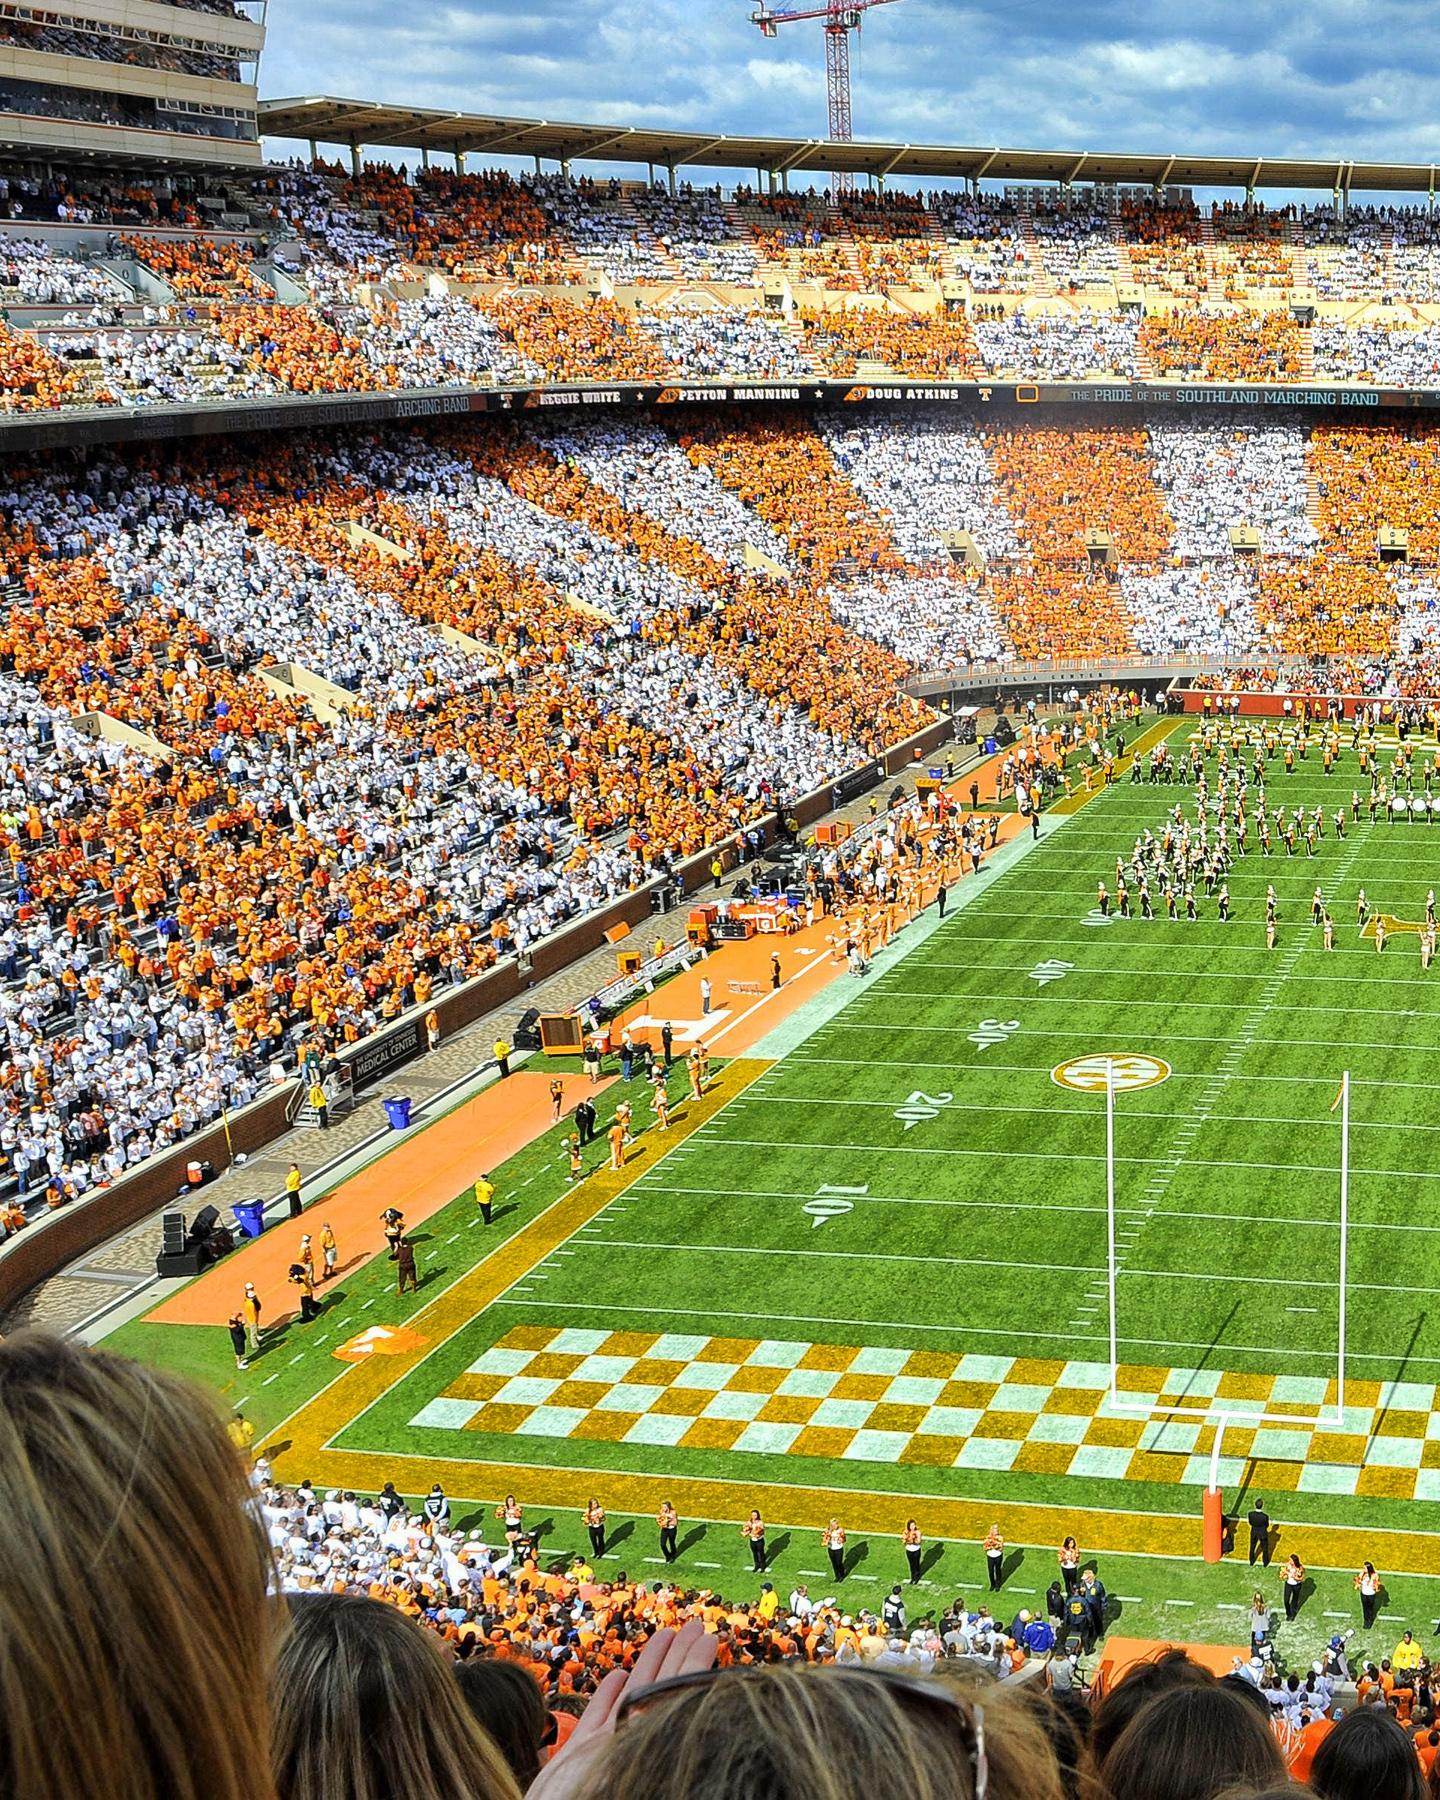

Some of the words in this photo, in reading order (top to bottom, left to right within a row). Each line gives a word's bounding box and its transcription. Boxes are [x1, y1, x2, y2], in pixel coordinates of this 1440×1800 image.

[540, 392, 579, 406] REGGIE
[582, 391, 621, 403] WHITE
[679, 389, 727, 401] PEYTON
[733, 388, 800, 400] MANNING
[866, 388, 902, 400] DOUG
[906, 388, 959, 400] ATKINS
[979, 388, 993, 401] T
[1072, 390, 1091, 401] THE
[1094, 389, 1133, 402] PRIDE
[1137, 391, 1149, 401] OF
[1152, 391, 1171, 401] THE
[1176, 389, 1259, 404] SOUTHLAND
[1264, 391, 1338, 405] MARCHING
[1341, 392, 1379, 406] BAND
[318, 403, 384, 423] SOUTHLAND
[389, 399, 441, 418] MARCHING
[443, 396, 470, 413] BAND
[966, 1018, 1020, 1044] 30
[357, 1050, 390, 1077] MEDICAL
[390, 1034, 418, 1057] CENTER
[892, 1090, 954, 1121] 20
[801, 1183, 869, 1216] 10
